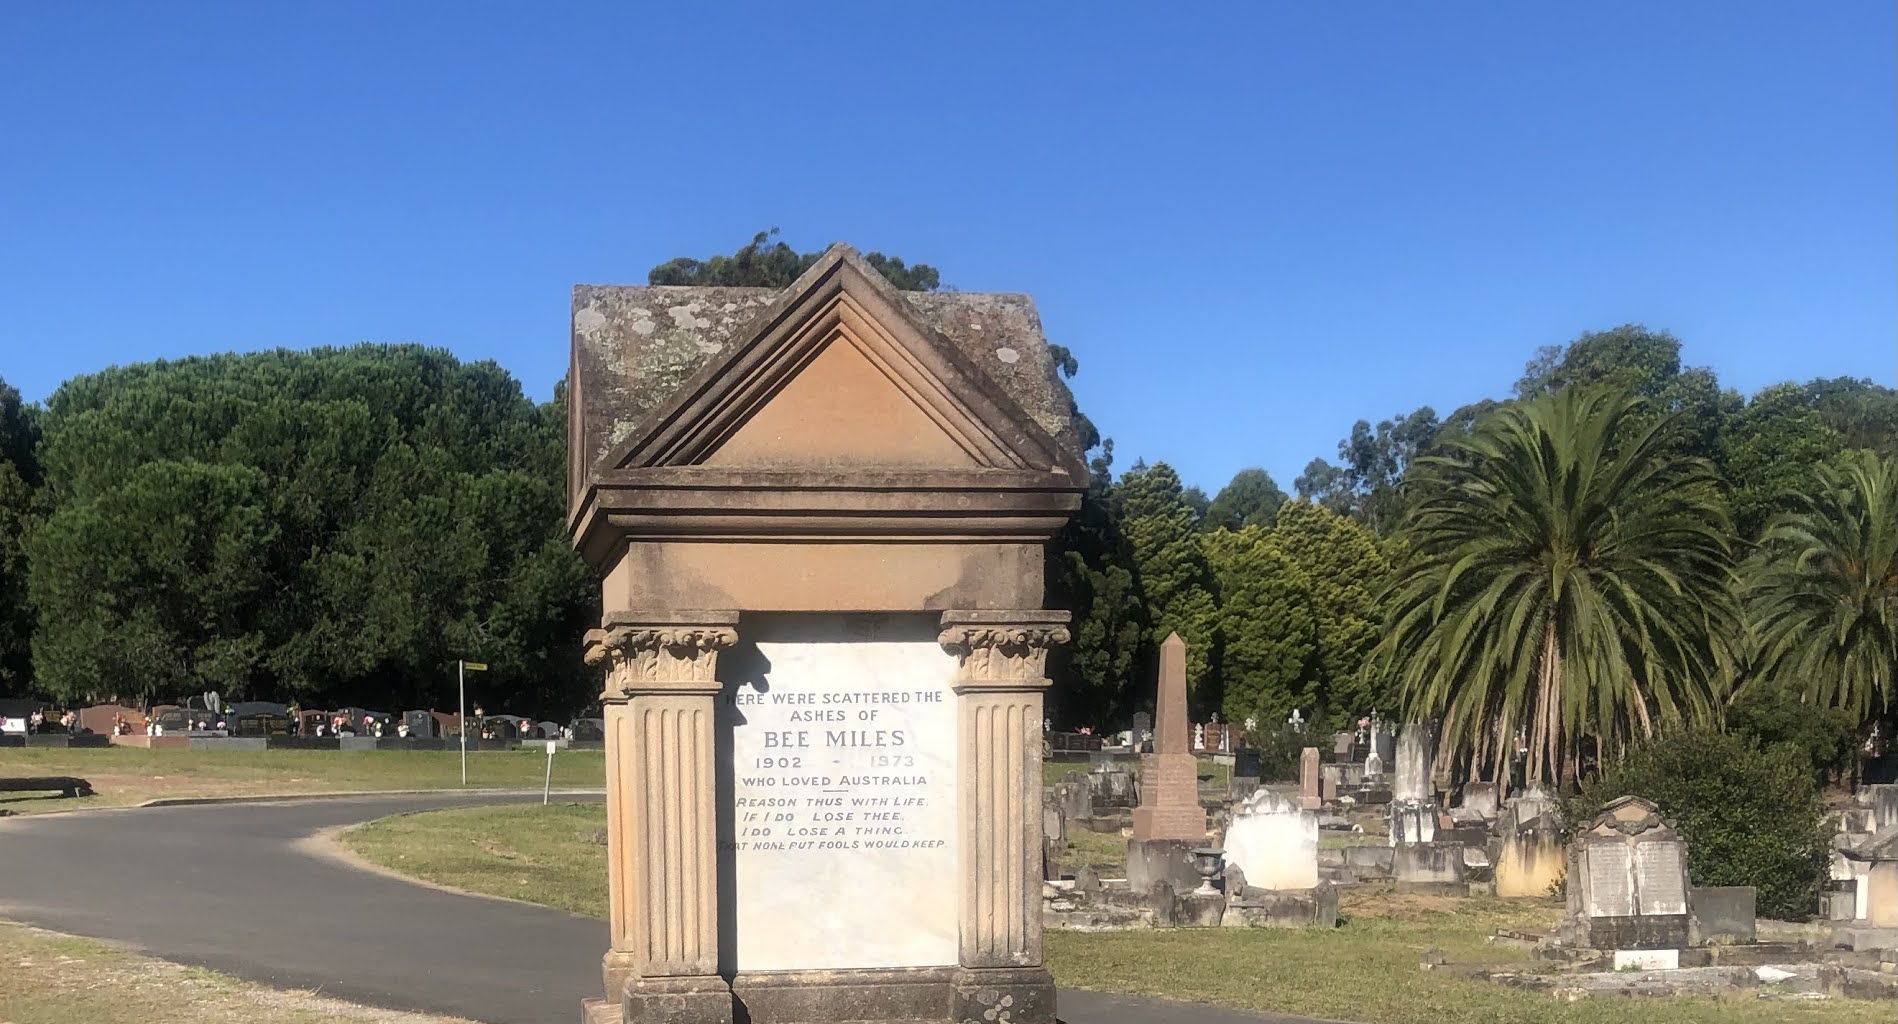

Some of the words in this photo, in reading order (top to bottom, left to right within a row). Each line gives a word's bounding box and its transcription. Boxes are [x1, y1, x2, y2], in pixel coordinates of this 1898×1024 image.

[726, 693, 765, 705] HERE
[772, 693, 816, 704] WERE
[822, 692, 910, 704] SCATTERED
[915, 691, 942, 702] THE
[790, 710, 846, 722] ASHES
[858, 710, 879, 721] OF
[764, 730, 810, 748] BEE
[826, 730, 905, 748] MILES
[756, 757, 802, 769] 1902
[870, 755, 915, 768] 1973
[742, 777, 776, 787] WHO
[782, 777, 831, 787] LOVED
[839, 775, 927, 786] AUSTRALIA
[736, 797, 797, 808] REASON
[806, 798, 843, 807] THUS
[851, 798, 889, 807] WITH
[743, 811, 758, 822] IF
[774, 813, 795, 822] DO
[812, 812, 854, 822] LOSE
[750, 828, 772, 837] DO
[787, 827, 829, 837] LOSE
[834, 827, 846, 836] A
[818, 840, 860, 850] FOOLS
[864, 840, 910, 850] WOULD
